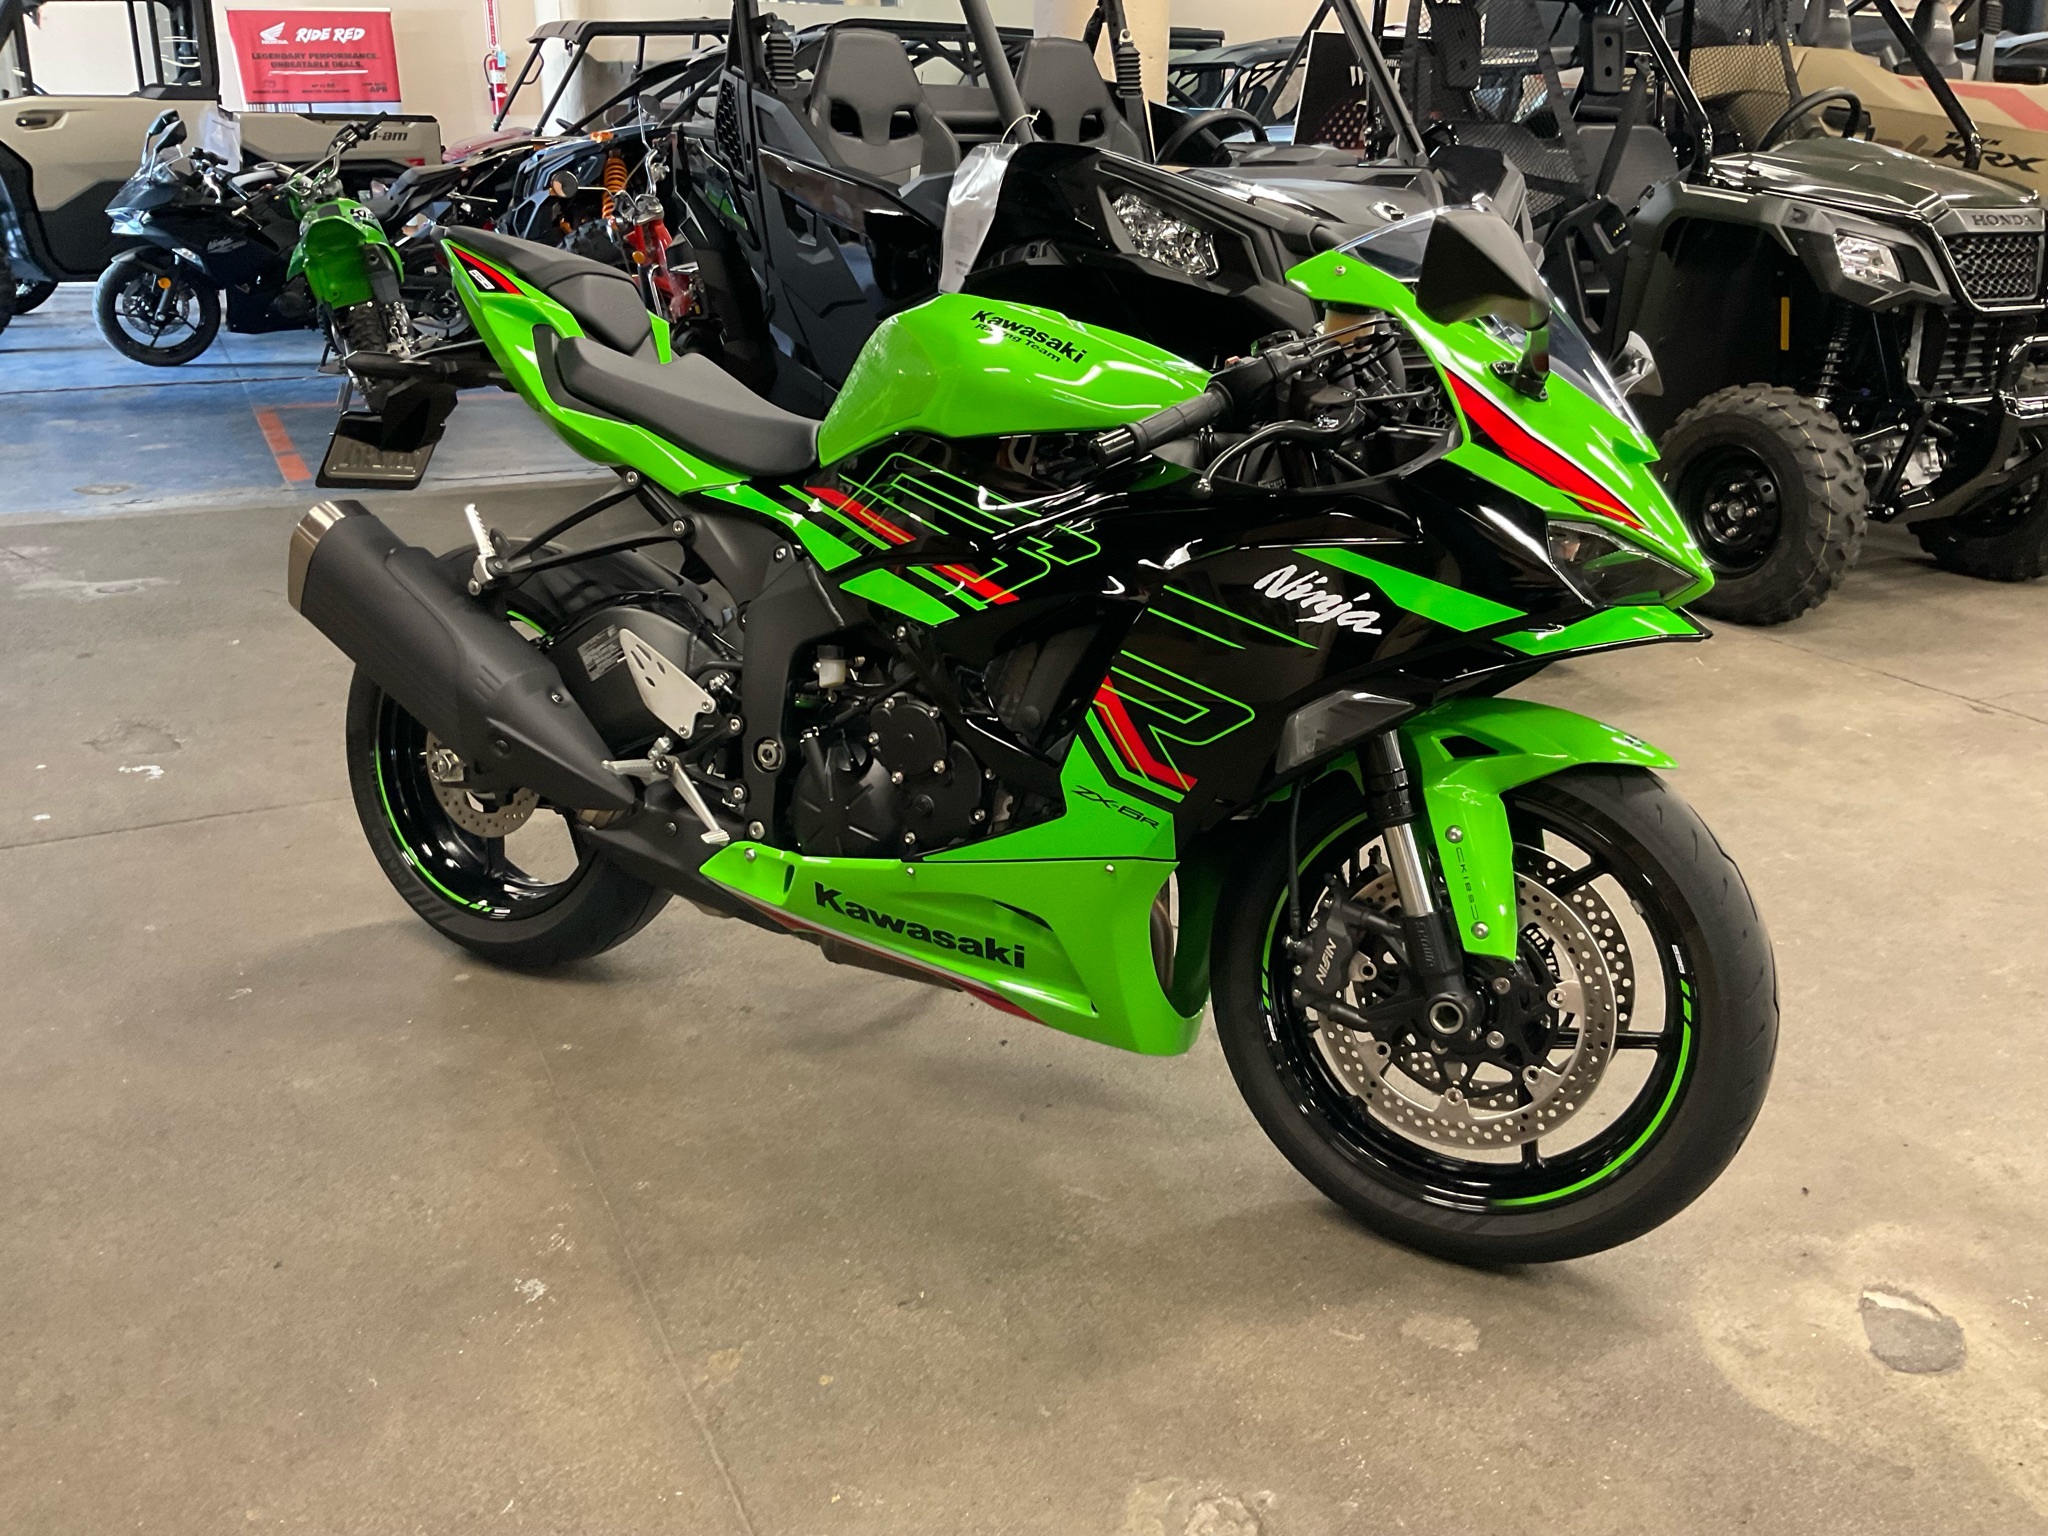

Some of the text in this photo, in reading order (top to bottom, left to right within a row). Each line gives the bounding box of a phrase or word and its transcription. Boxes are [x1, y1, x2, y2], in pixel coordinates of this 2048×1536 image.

[251, 52, 306, 60] LEGENDARY
[295, 27, 366, 45] RIDE RED
[270, 61, 330, 69] UNBEATABLE
[1971, 214, 2036, 227] HONDA
[970, 310, 1088, 364] Kawasaki
[974, 323, 1062, 363] Raing Team
[1253, 564, 1383, 636] Ninja
[1071, 785, 1160, 829] ZX-6R
[814, 880, 1025, 970] Kawasaki
